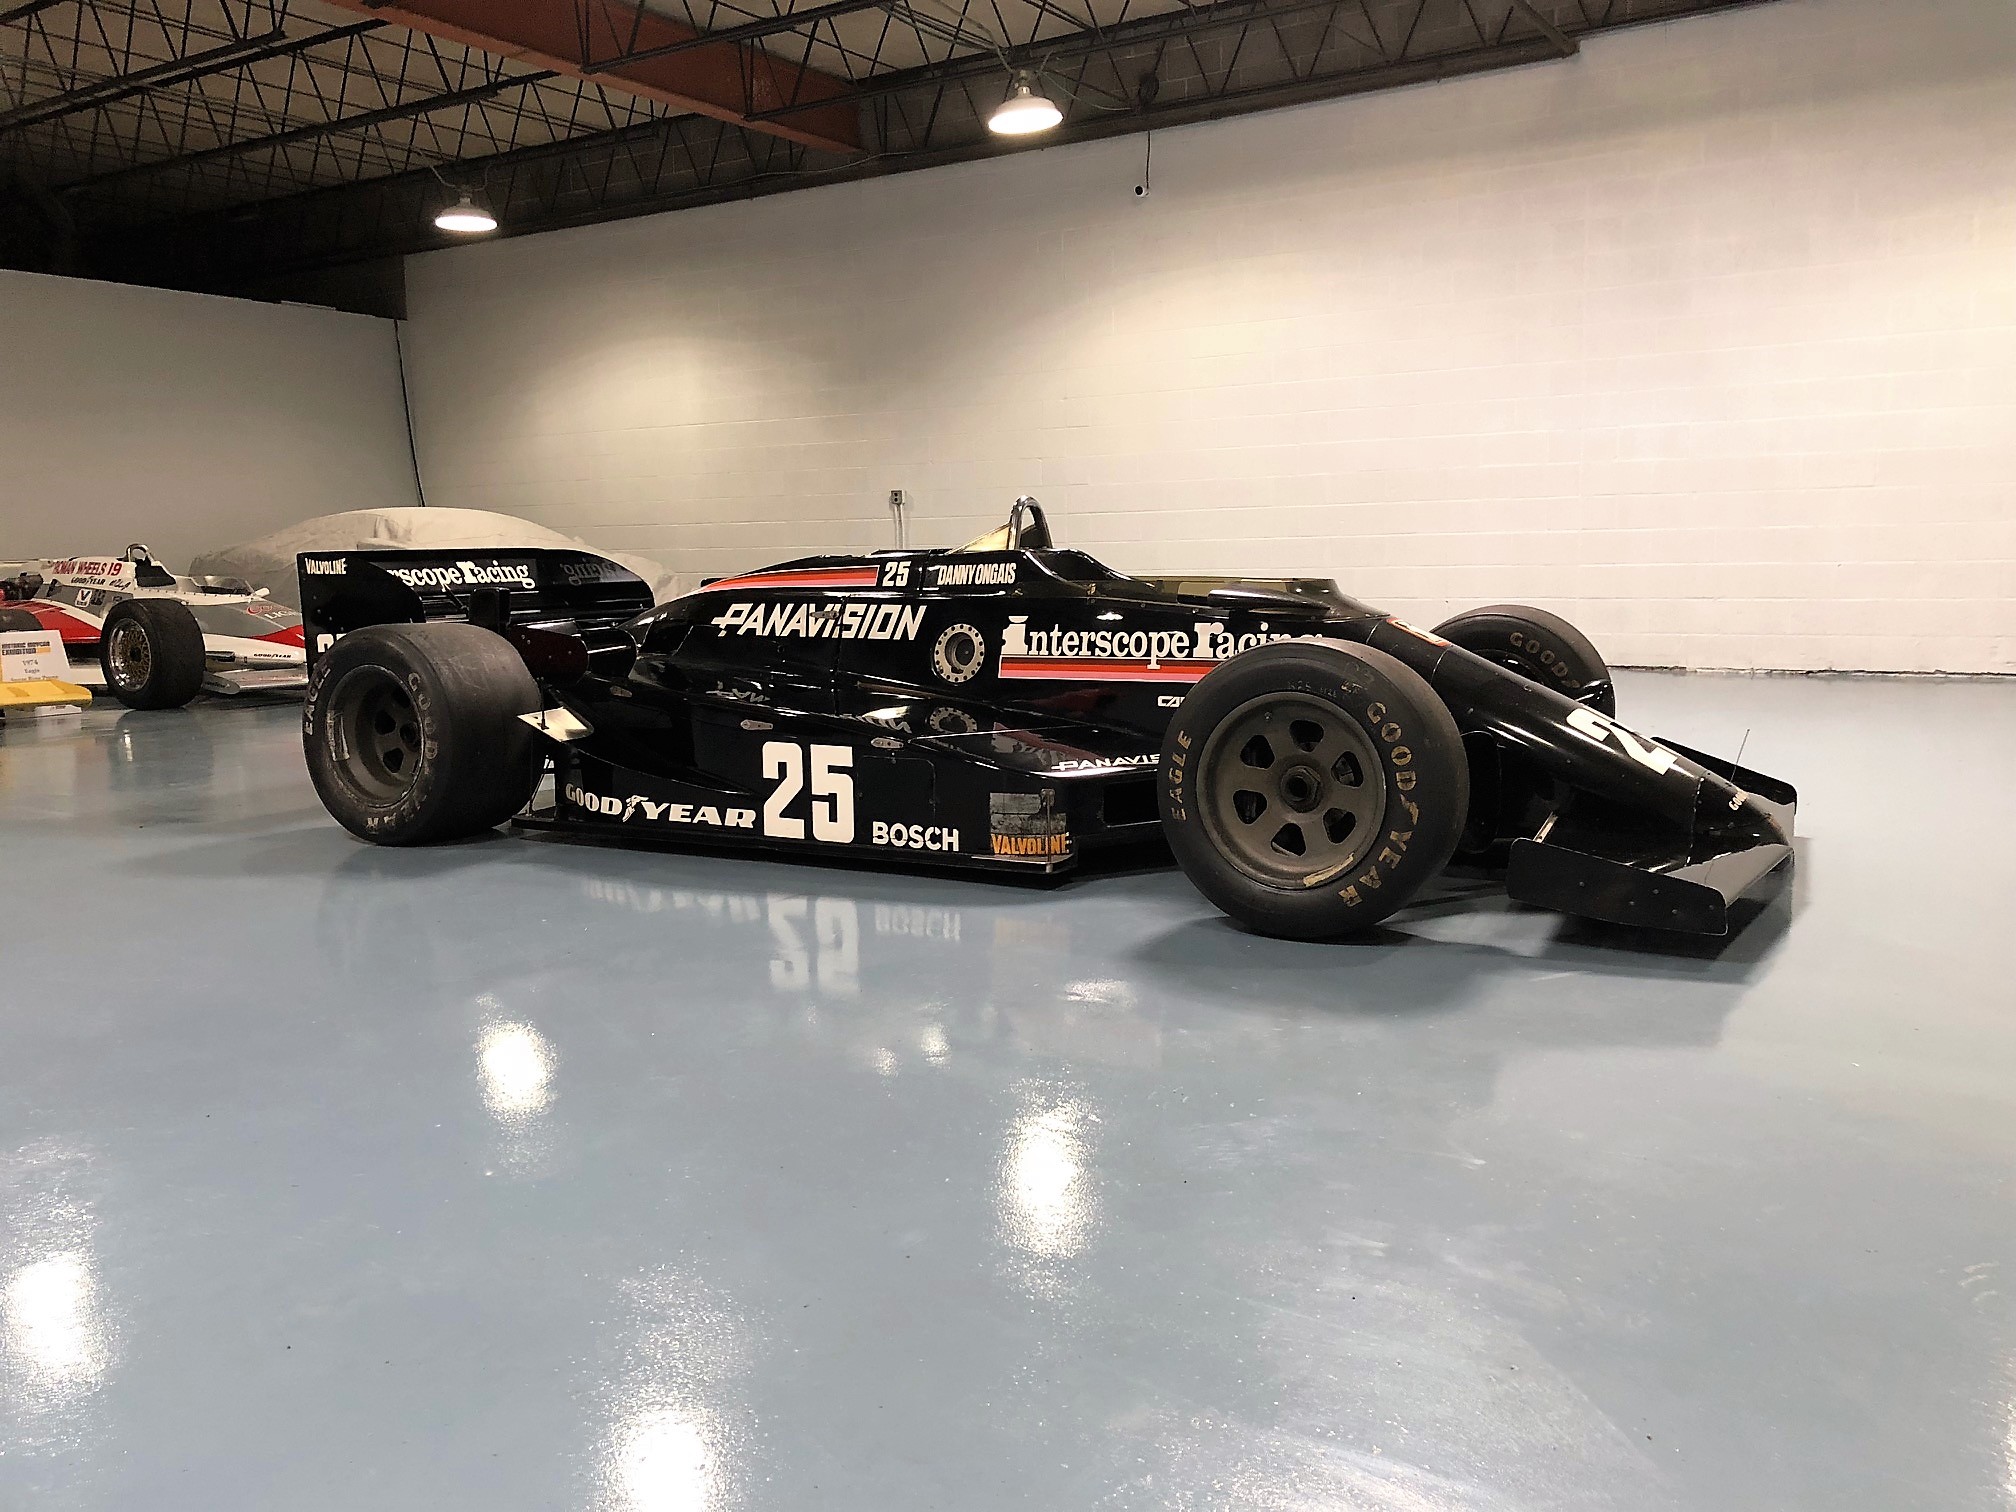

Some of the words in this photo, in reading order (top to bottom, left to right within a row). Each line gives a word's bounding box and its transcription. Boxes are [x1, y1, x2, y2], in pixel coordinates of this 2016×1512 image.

[107, 562, 123, 576] 19
[305, 557, 347, 574] VALVOLINE
[882, 561, 911, 586] 25
[937, 564, 976, 586] DANNY
[975, 562, 1017, 585] ONGAIS
[711, 602, 927, 641] PANAVISION
[1193, 621, 1323, 659] raci
[1167, 729, 1193, 822] EAGLE
[762, 741, 855, 844] 25
[872, 821, 960, 852] BOSCH
[991, 832, 1073, 855] VALVOLINE
